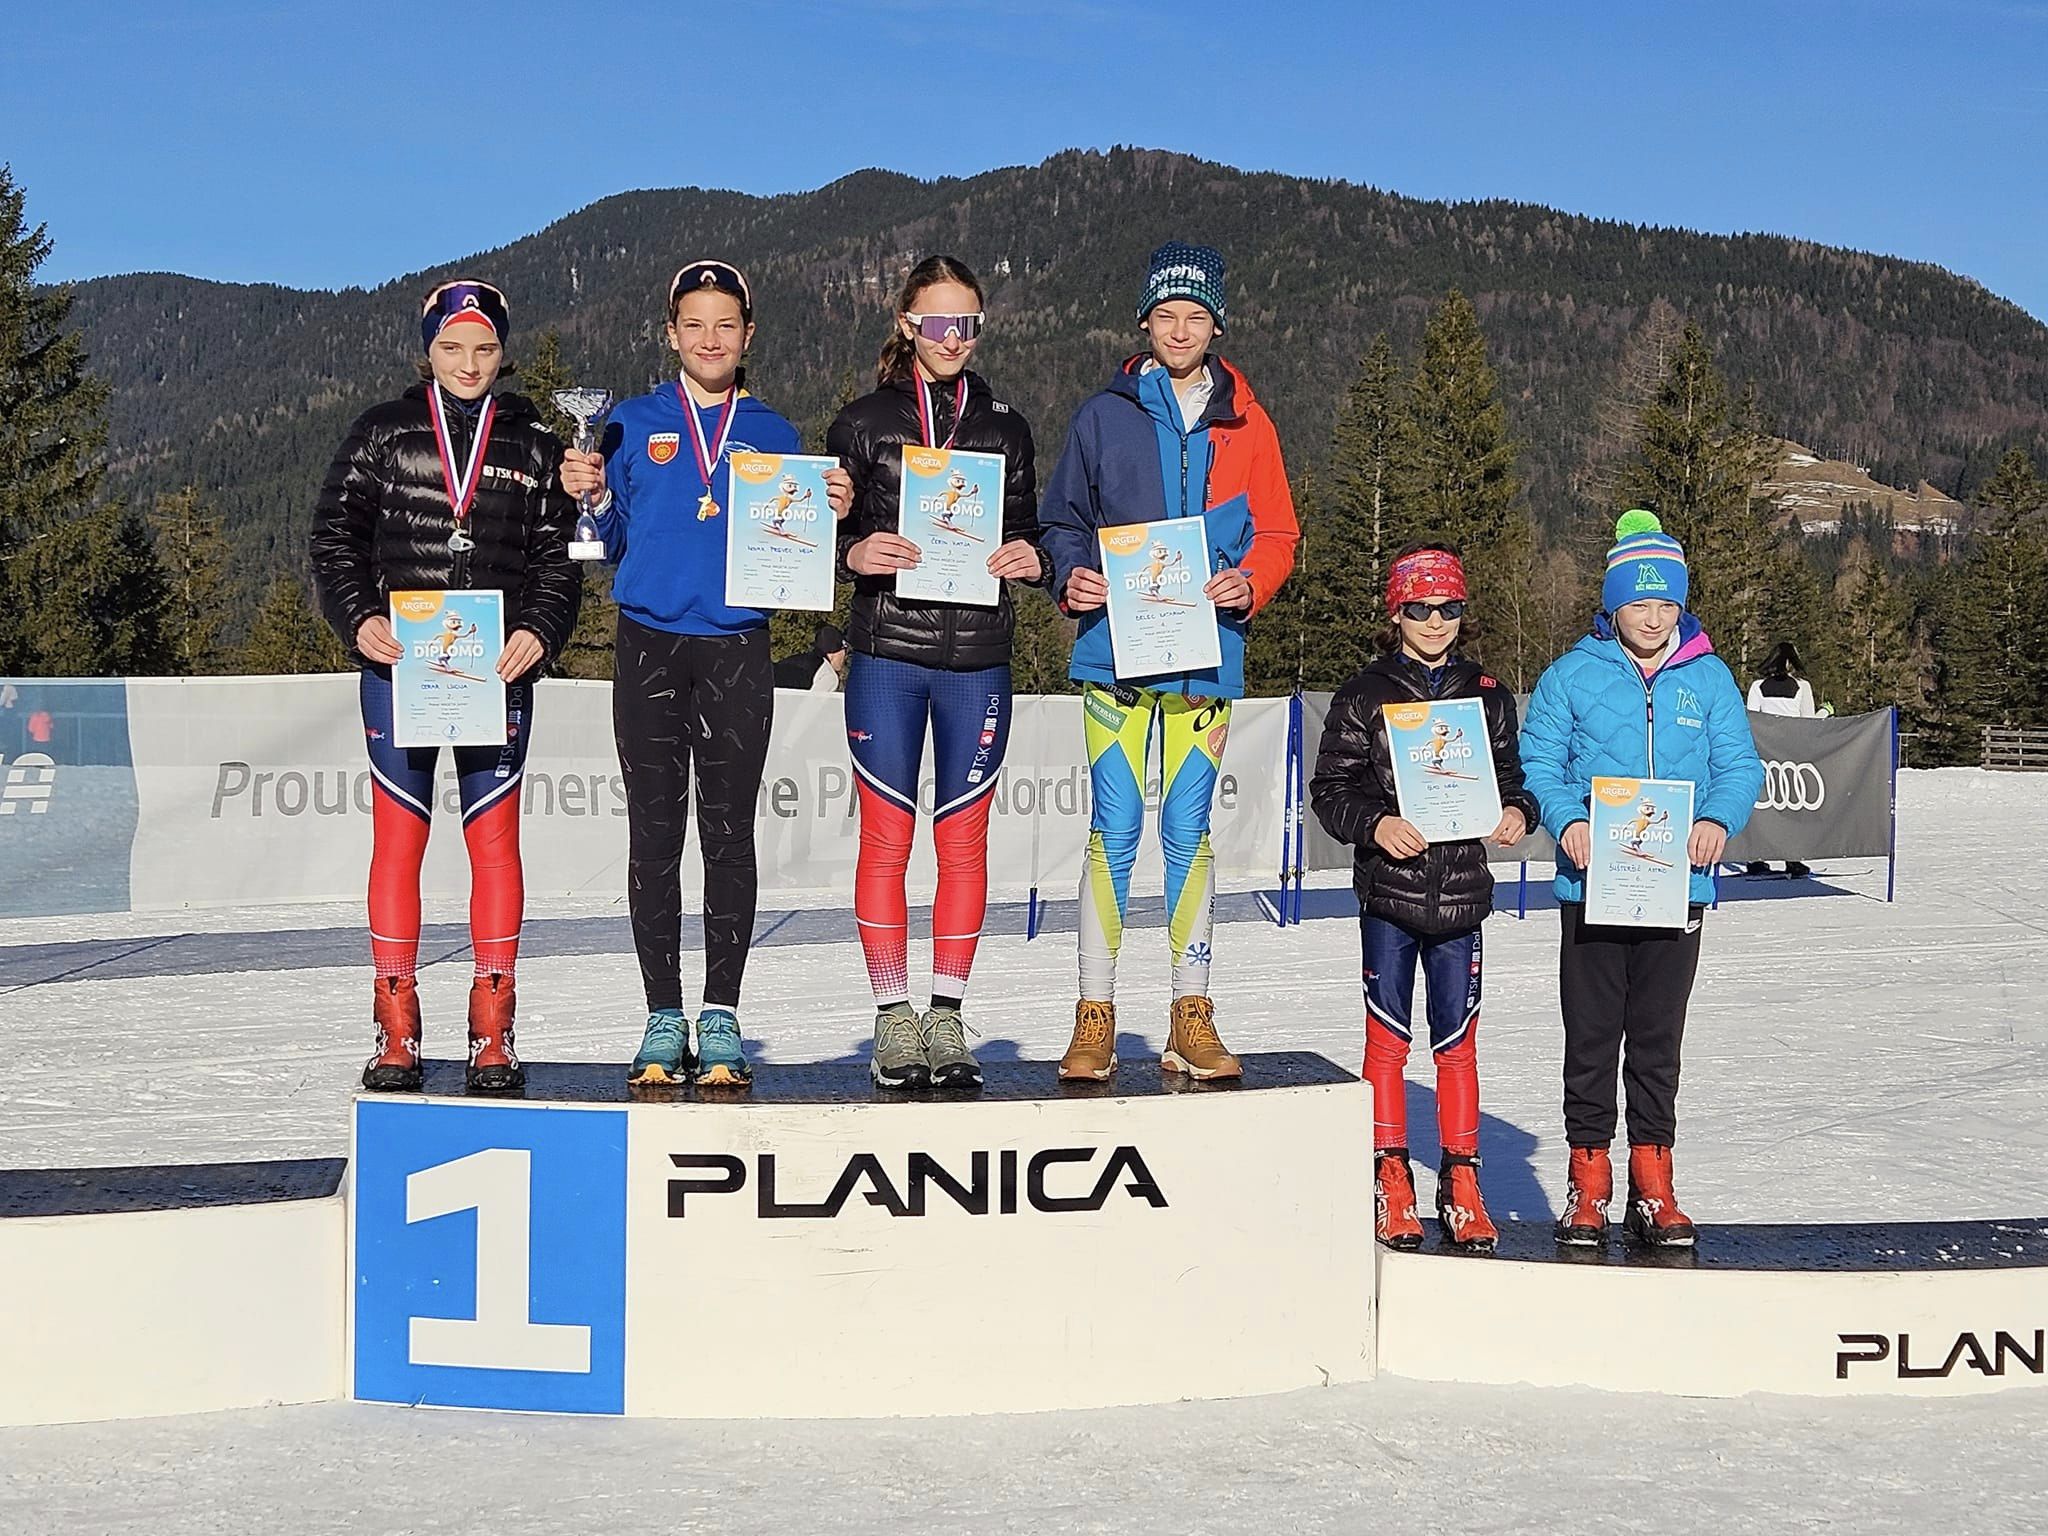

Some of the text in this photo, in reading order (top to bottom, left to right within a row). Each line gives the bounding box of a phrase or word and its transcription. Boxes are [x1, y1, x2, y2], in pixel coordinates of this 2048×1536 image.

[496, 467, 512, 480] TSK
[750, 507, 818, 522] DIPLOMO
[919, 500, 984, 517] DIPLOMO
[1125, 571, 1192, 591] DIPLOMO
[400, 599, 436, 612] ARGETA
[414, 644, 484, 659] DIPLOMO
[972, 747, 991, 769] TSK
[986, 694, 1000, 716] Dol
[1409, 747, 1473, 763] DIPLOMO
[1609, 829, 1673, 844] DIPLOMO
[1472, 931, 1481, 950] Dol
[1468, 976, 1479, 995] TSK
[667, 1145, 1170, 1218] PLANICA
[406, 1148, 592, 1374] 1
[1836, 1329, 2045, 1379] PLAN
